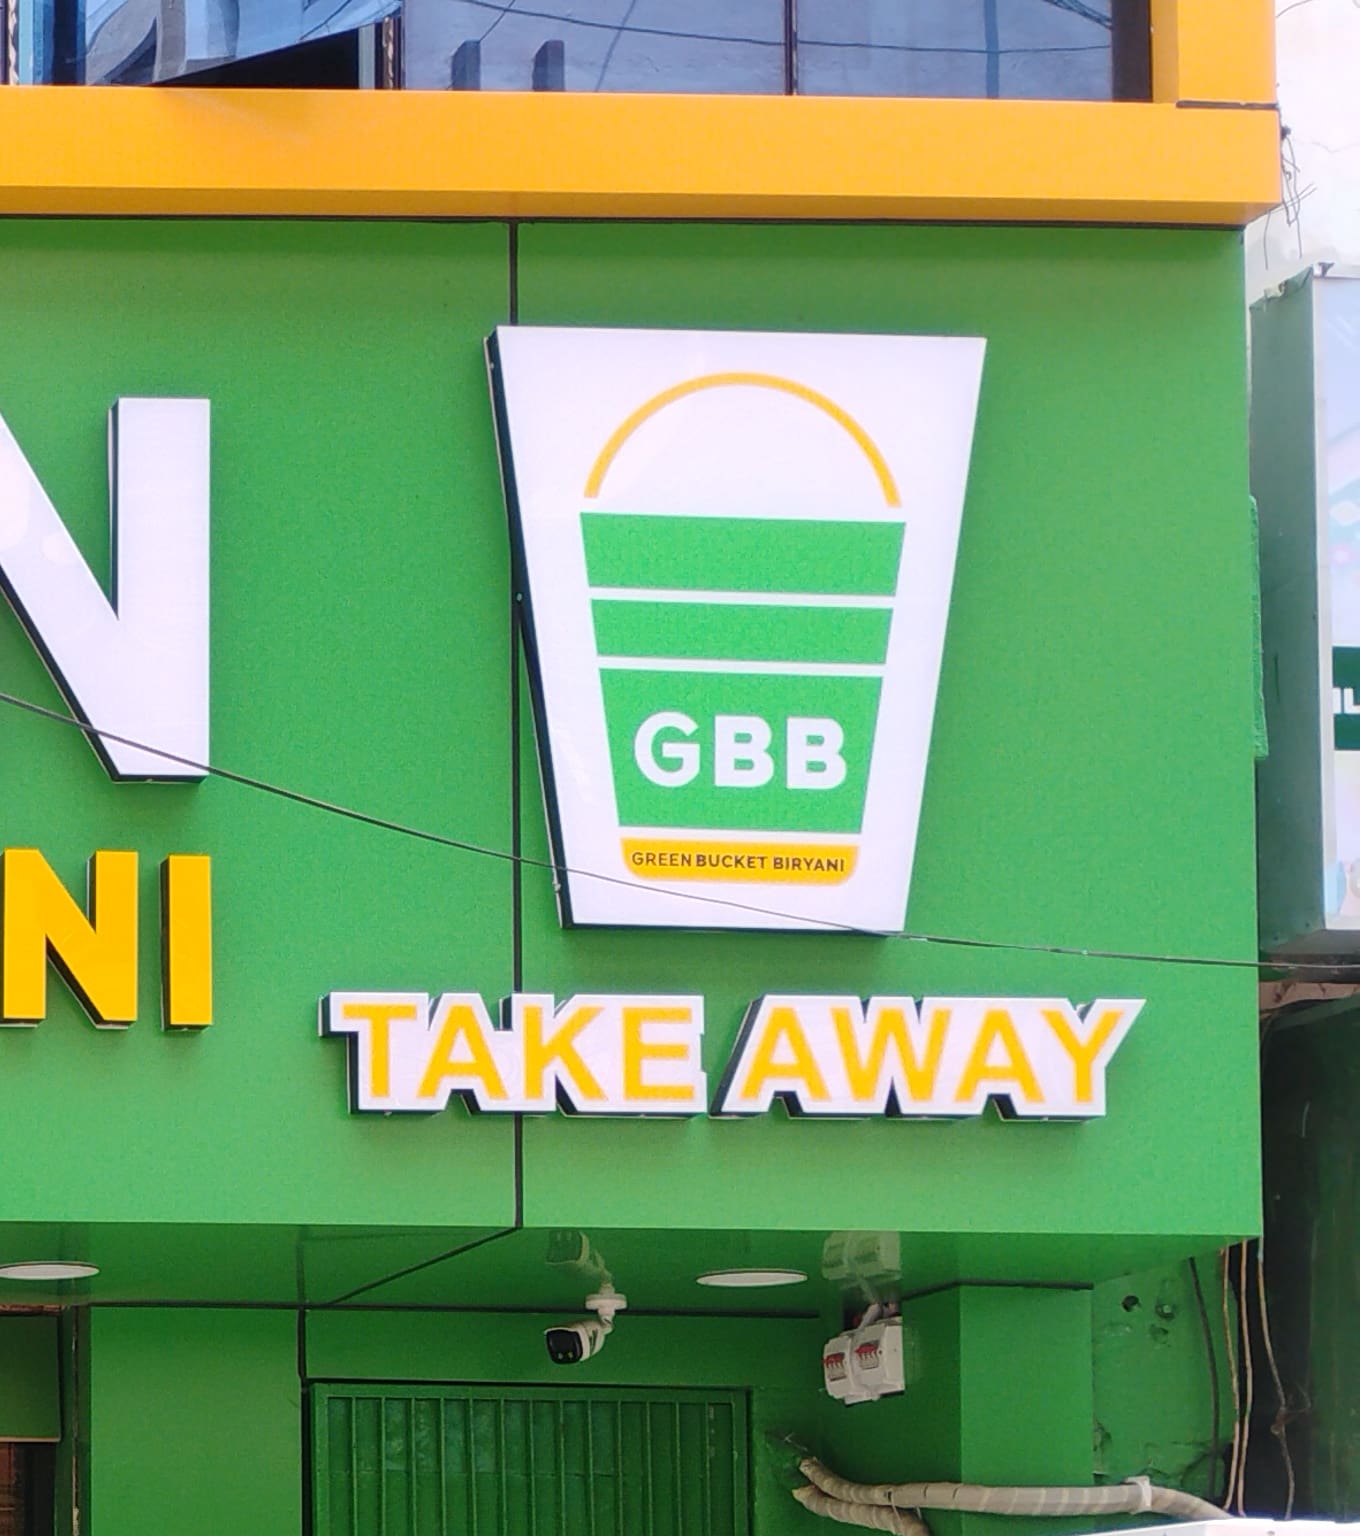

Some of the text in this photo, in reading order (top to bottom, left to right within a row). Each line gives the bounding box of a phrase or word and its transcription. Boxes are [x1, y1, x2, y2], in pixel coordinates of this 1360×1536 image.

[634, 711, 848, 790] GBB
[631, 851, 845, 873] GREEN BUCKET BIRYANI
[333, 995, 1138, 1112] TAKE AWAY
